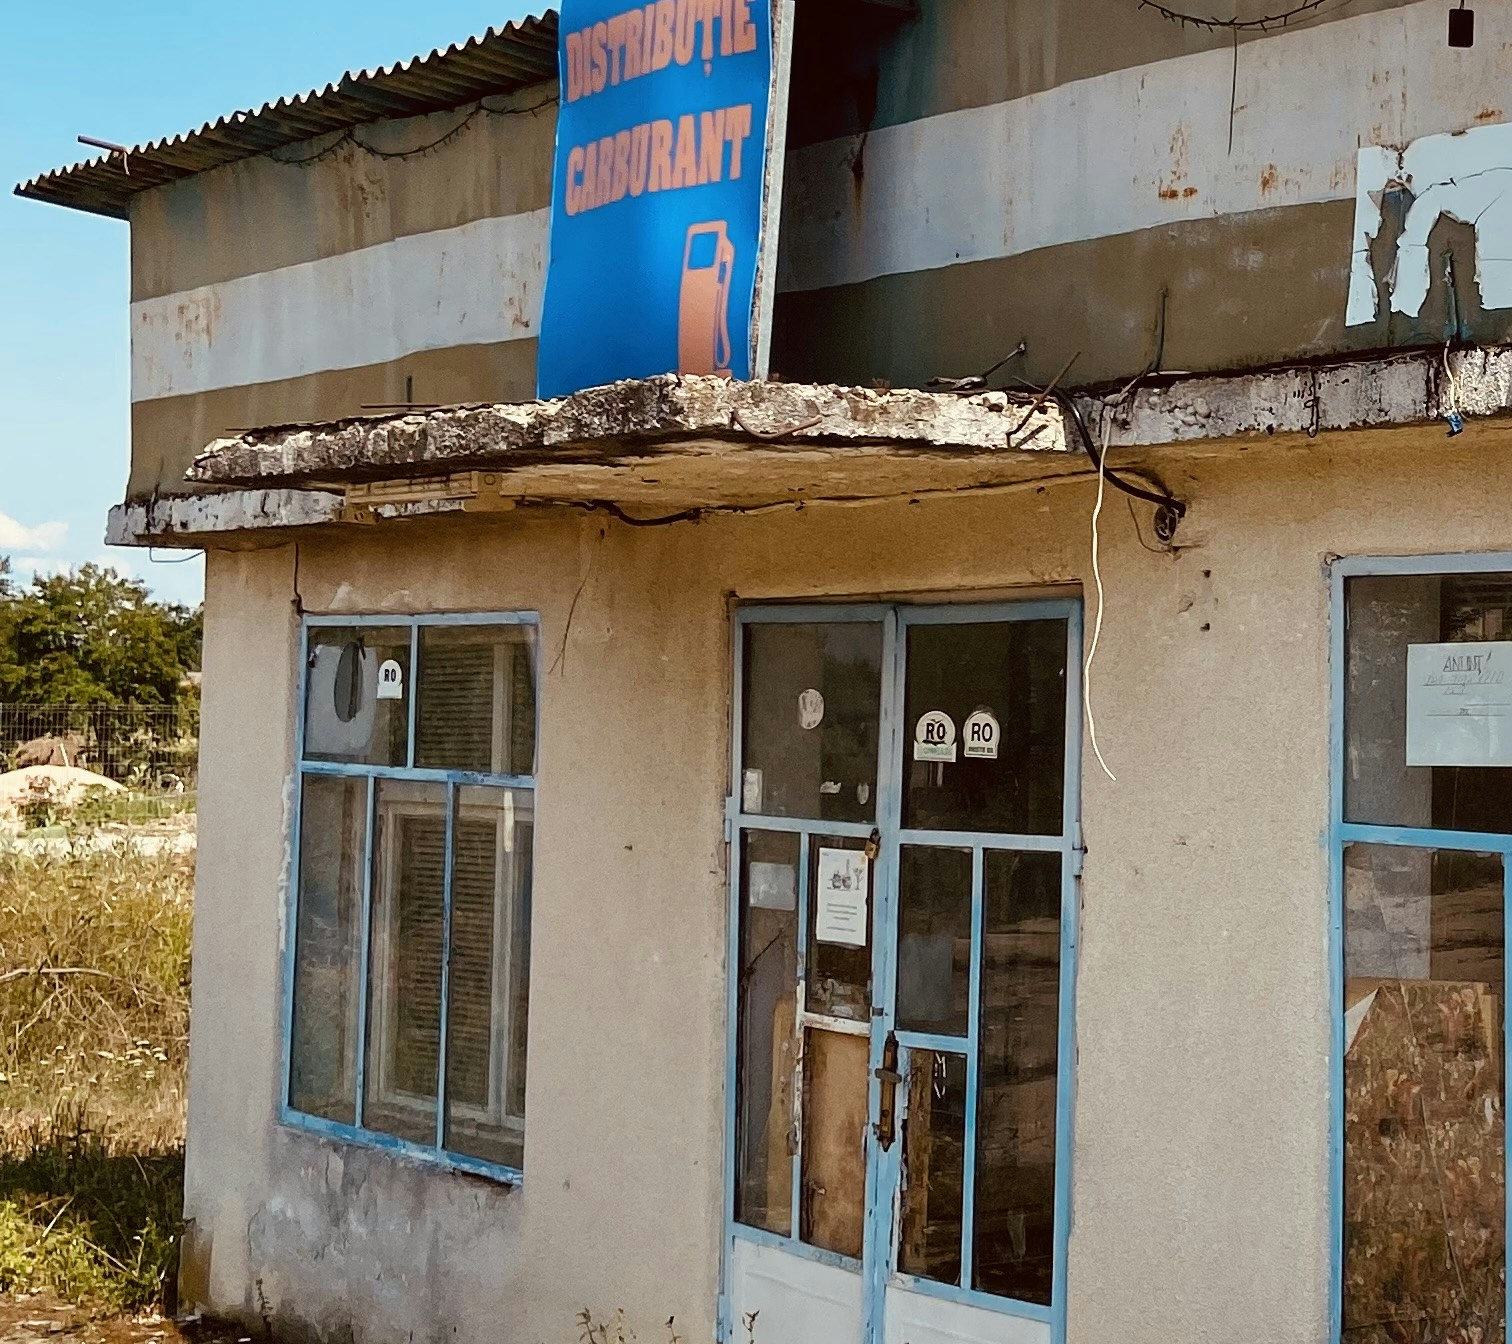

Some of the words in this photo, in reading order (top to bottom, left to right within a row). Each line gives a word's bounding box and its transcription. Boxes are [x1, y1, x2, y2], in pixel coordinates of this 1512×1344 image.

[565, 103, 752, 217] CARBURANT
[384, 668, 397, 682] RO
[926, 722, 946, 740] RO
[970, 722, 993, 742] RO
